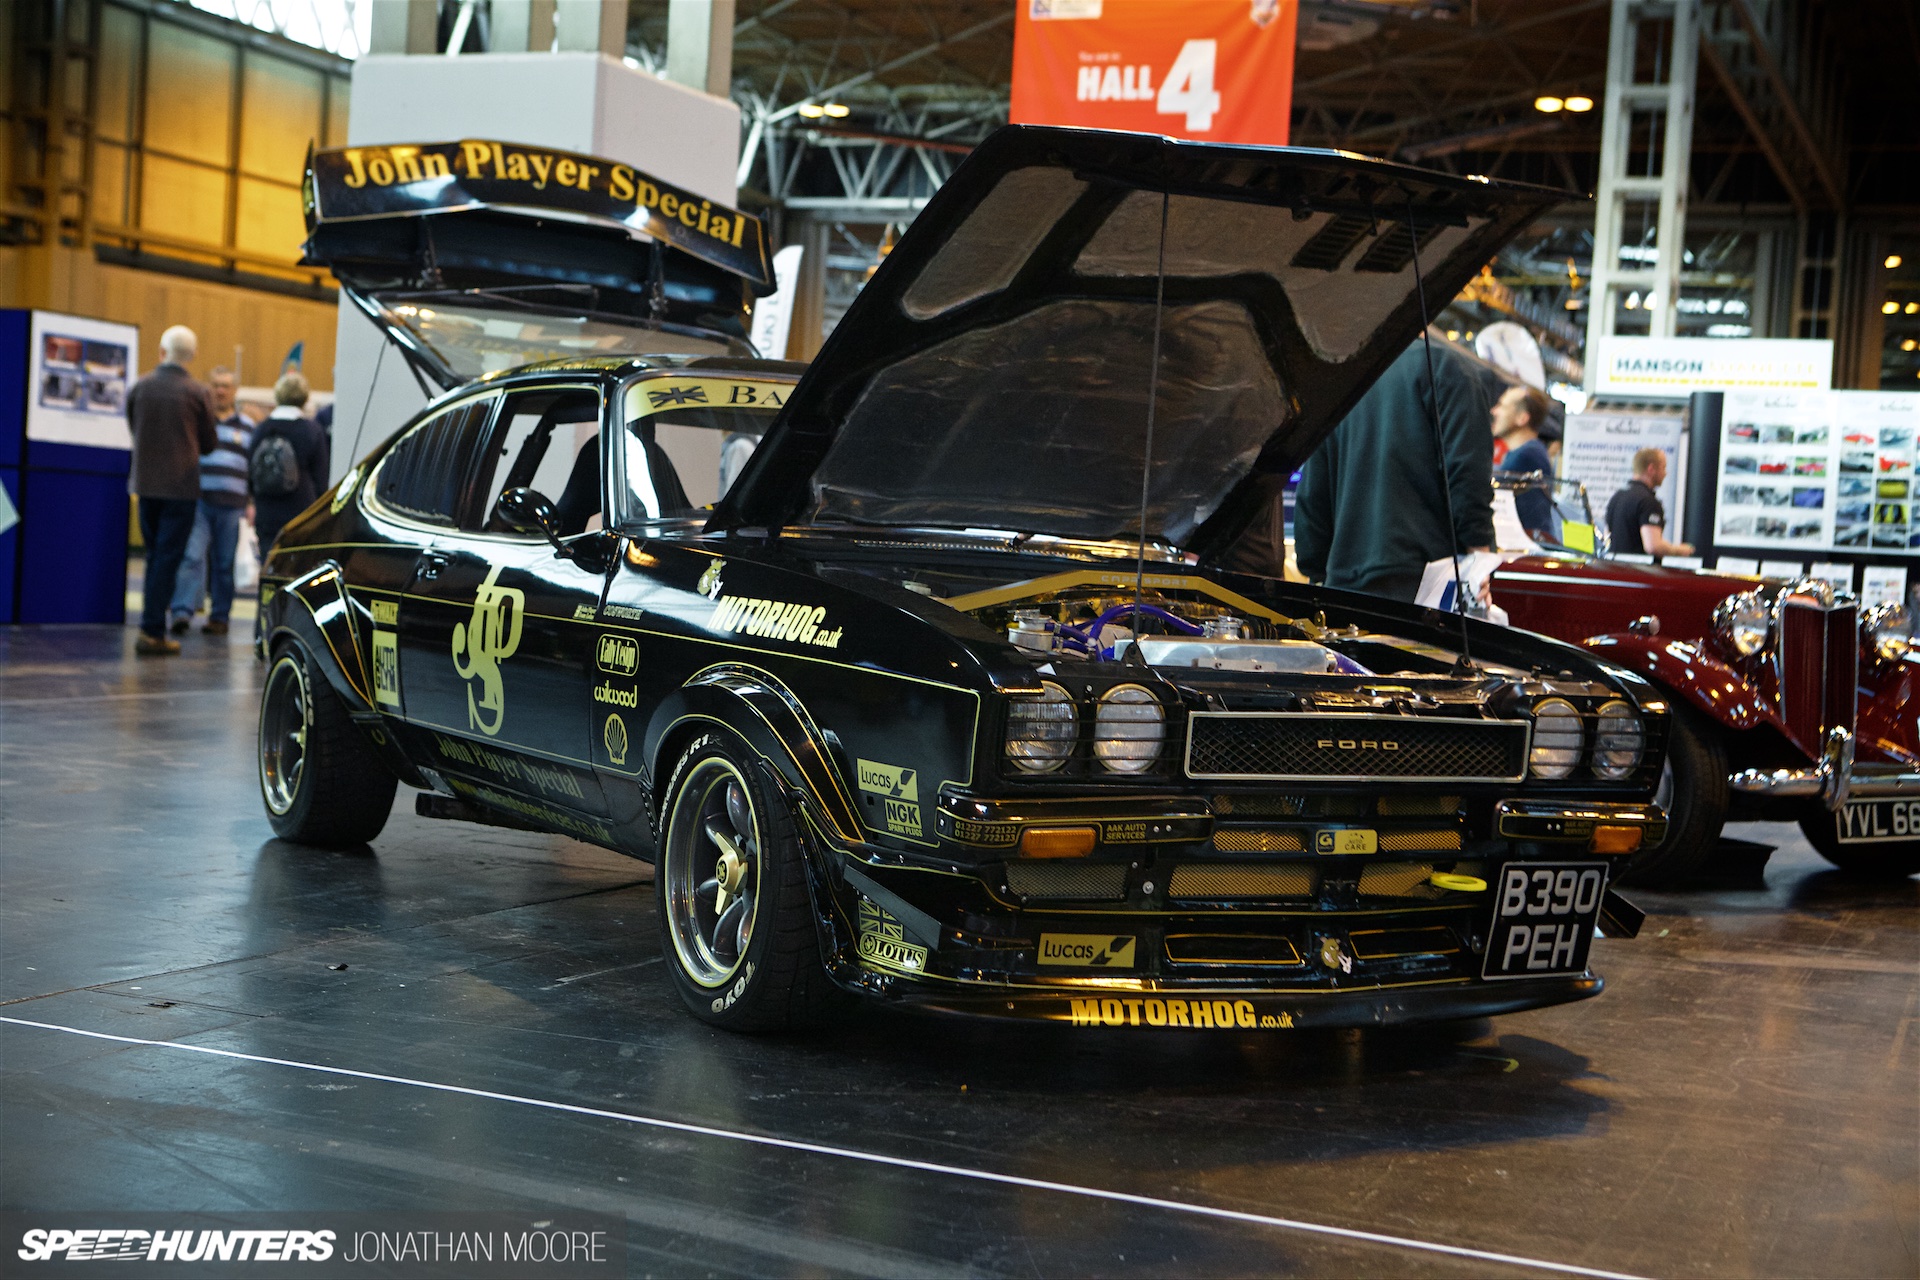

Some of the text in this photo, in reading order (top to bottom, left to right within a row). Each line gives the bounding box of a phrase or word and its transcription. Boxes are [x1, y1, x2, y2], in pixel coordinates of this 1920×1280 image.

[1077, 39, 1220, 131] HALL 4
[344, 142, 745, 248] John Player Special
[1617, 359, 1702, 373] HANSON
[1144, 577, 1188, 586] SPORT
[594, 680, 638, 708] wilwood
[1317, 740, 1399, 750] FORD
[433, 732, 584, 799] John Player Special
[861, 766, 891, 789] Lucas
[887, 802, 919, 825] NGK
[1842, 804, 1888, 837] YVL
[888, 823, 923, 837] SPARK PLUGS
[954, 829, 1016, 842] 01227 772123
[955, 821, 1016, 834] 01227 772122
[1106, 831, 1146, 839] SERVICES
[1107, 823, 1146, 832] AAK AUTO
[1501, 869, 1600, 916] B390
[874, 940, 922, 967] LOTUS
[1044, 939, 1094, 958] Lucas
[1502, 924, 1579, 971] PEH
[711, 961, 756, 1013] TOYO
